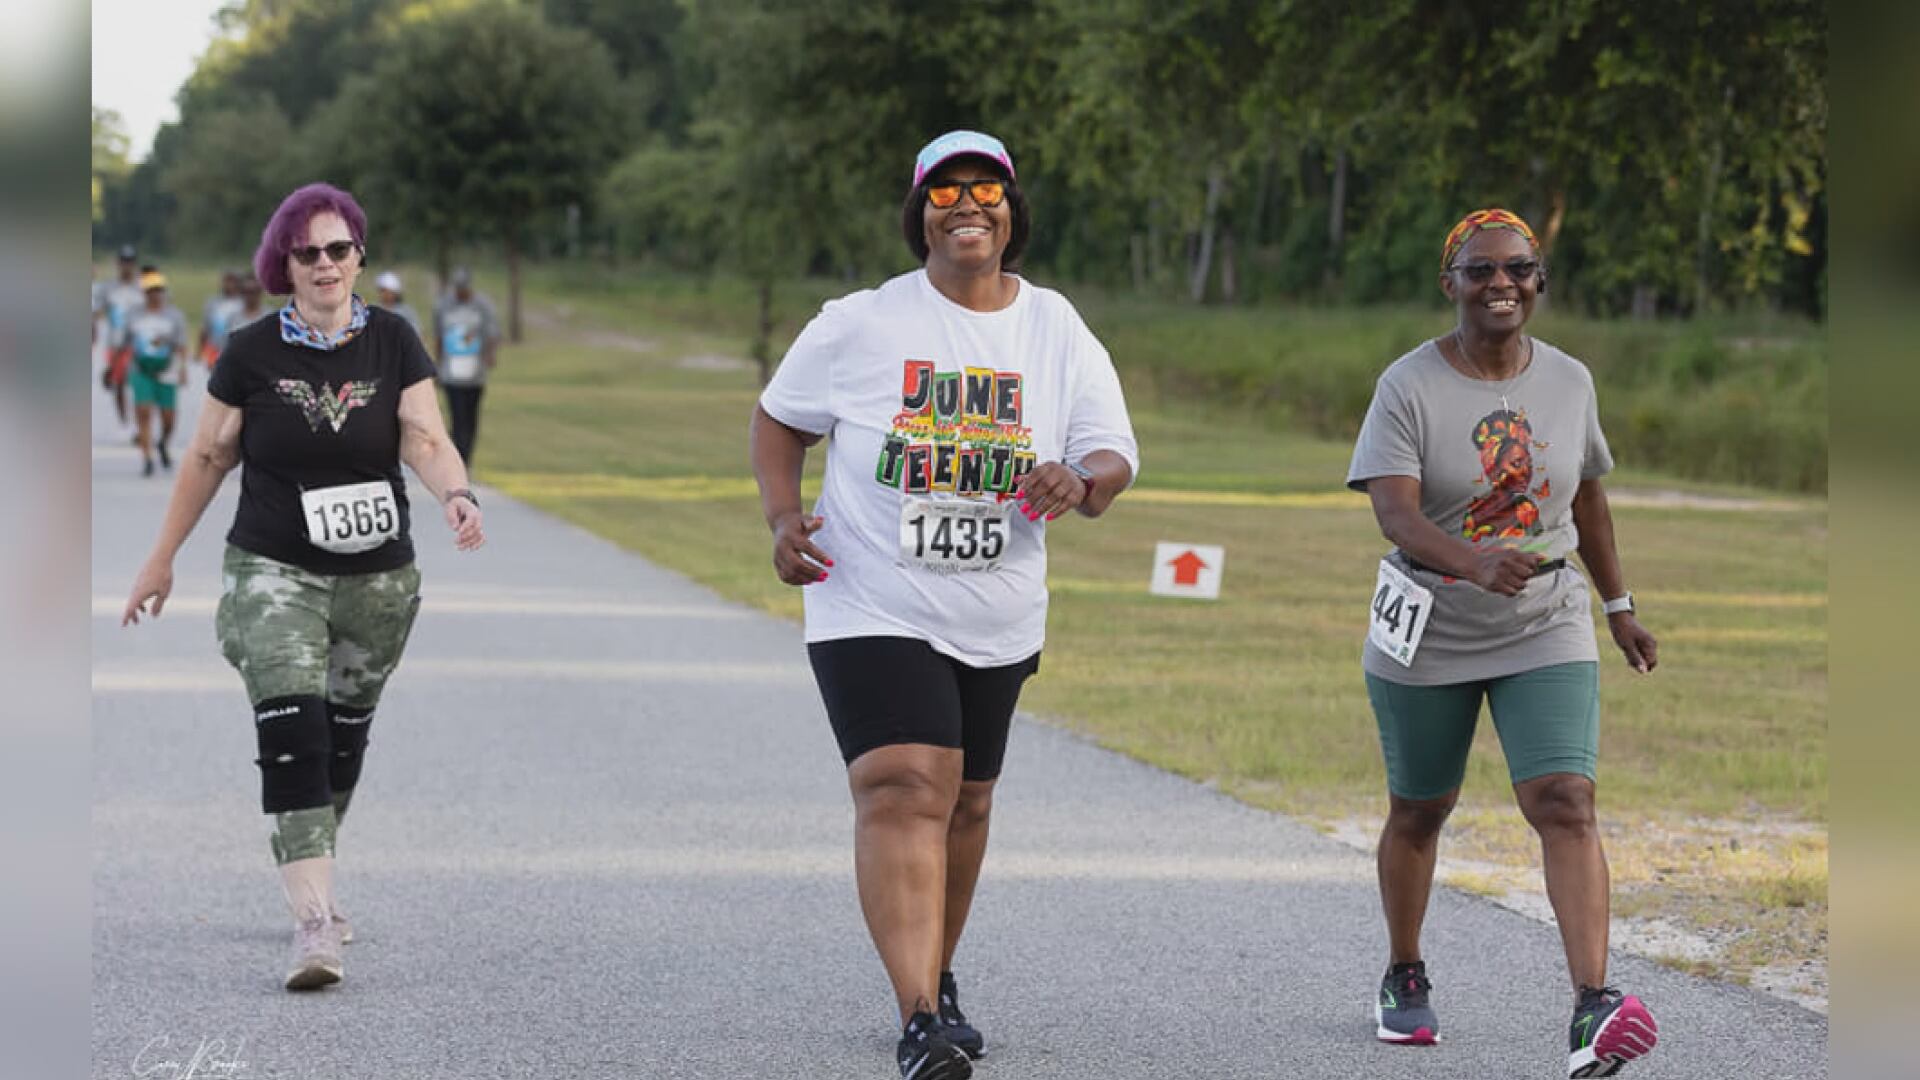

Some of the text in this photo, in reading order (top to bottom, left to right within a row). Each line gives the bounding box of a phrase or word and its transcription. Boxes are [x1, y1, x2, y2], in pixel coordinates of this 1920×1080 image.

[903, 366, 1020, 423] JUNE
[883, 438, 1035, 494] TEENTH
[313, 496, 393, 541] 1365
[909, 515, 1004, 560] 1435
[1374, 583, 1420, 643] 441
